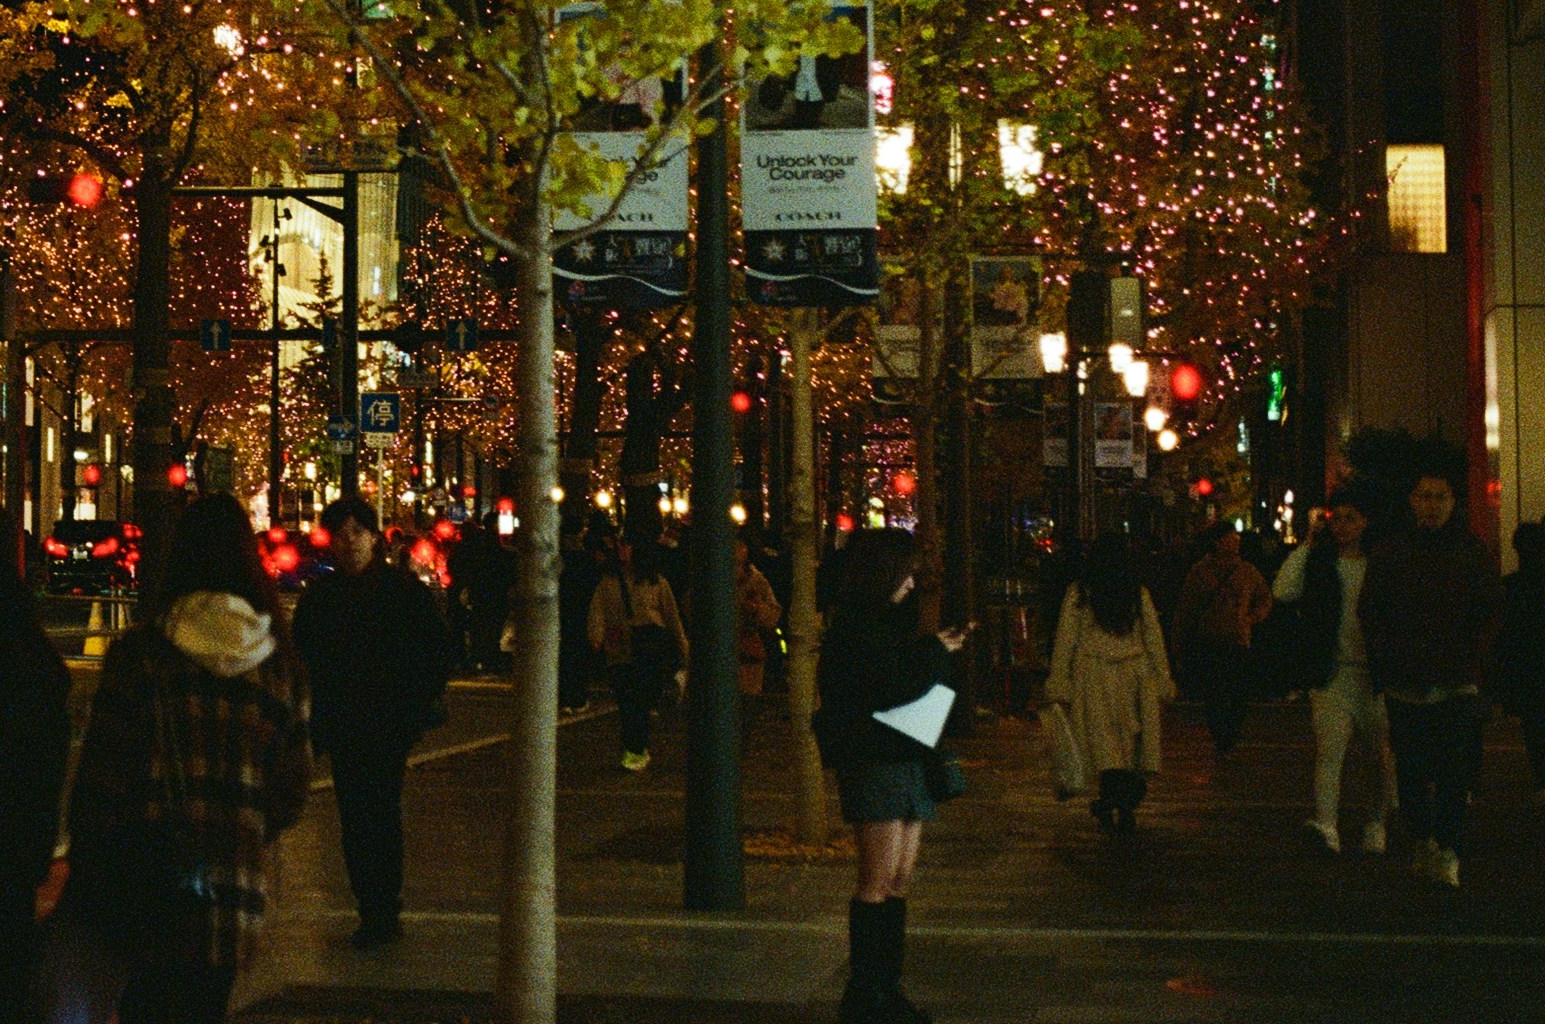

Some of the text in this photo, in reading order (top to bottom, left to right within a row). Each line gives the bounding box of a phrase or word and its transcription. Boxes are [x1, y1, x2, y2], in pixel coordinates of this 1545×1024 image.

[757, 154, 858, 169] Unlock Your
[769, 167, 846, 182] Courage
[776, 211, 842, 221] COACH
[367, 400, 395, 427] 停
